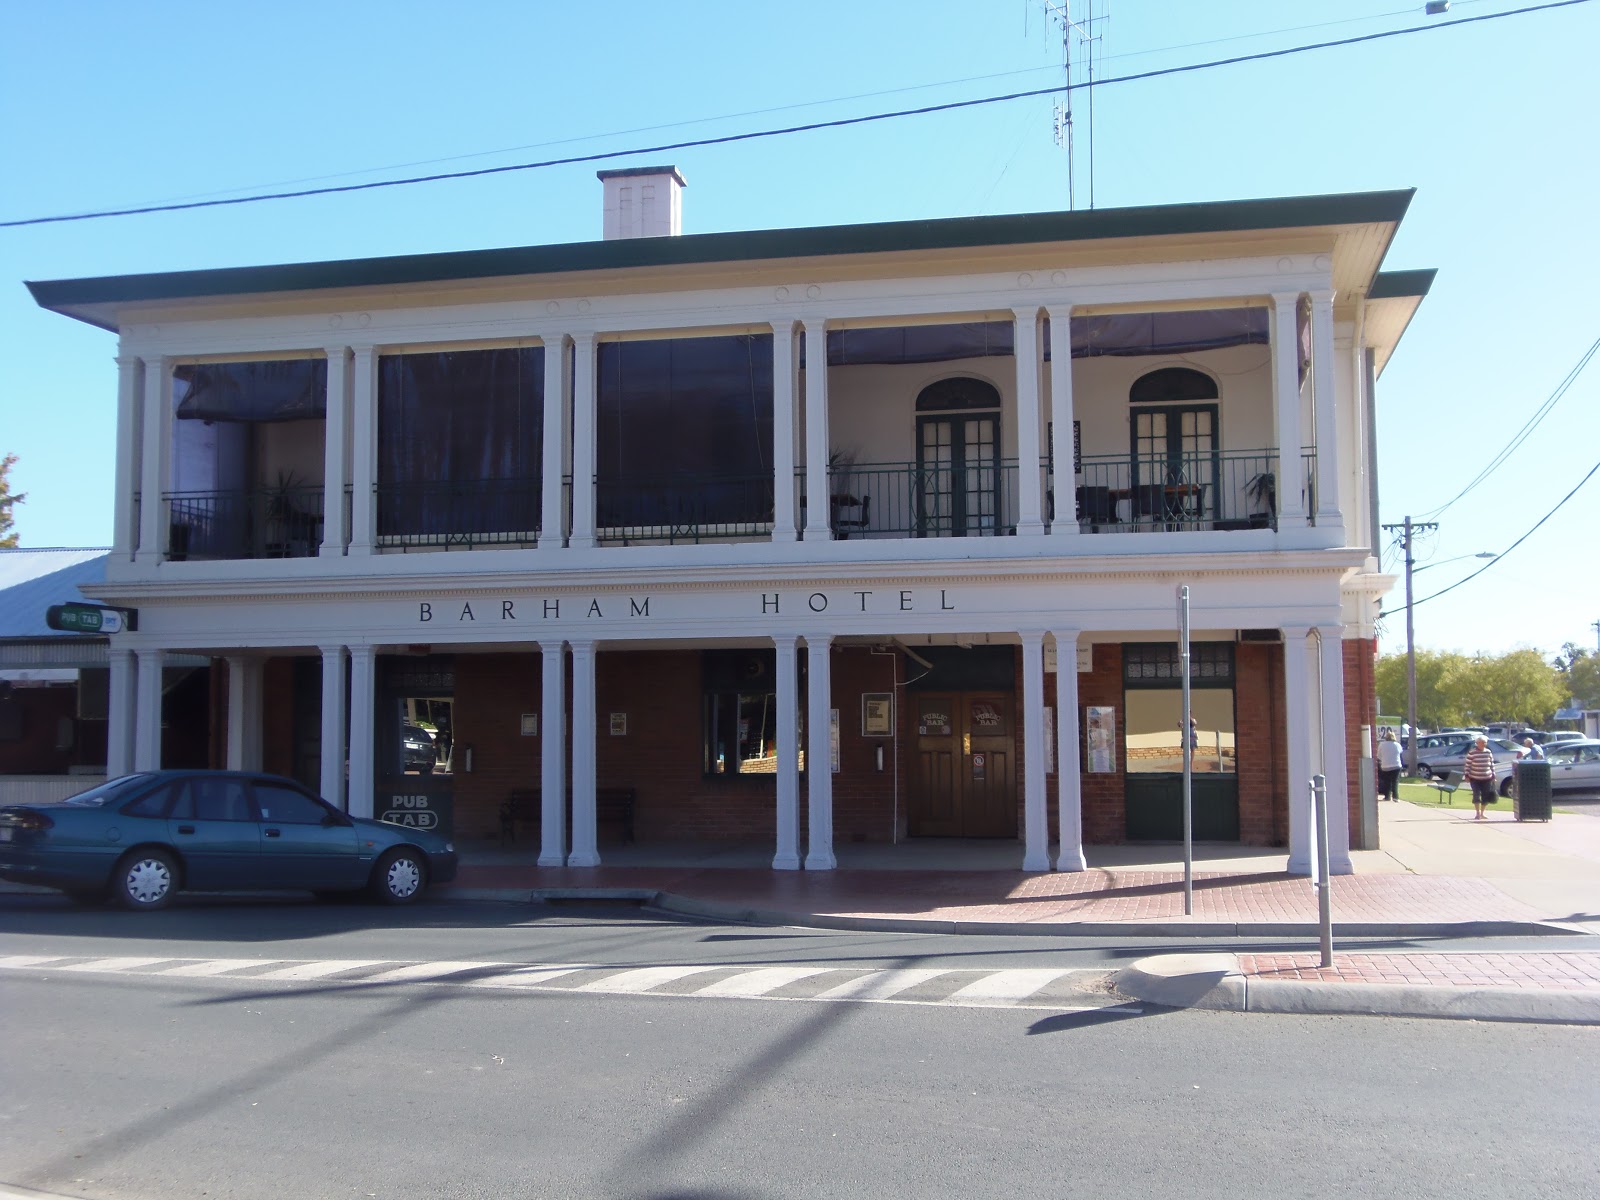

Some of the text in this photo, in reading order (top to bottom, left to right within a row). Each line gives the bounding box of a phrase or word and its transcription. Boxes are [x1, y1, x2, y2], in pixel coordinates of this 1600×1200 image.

[419, 590, 955, 622] BARHAM HOTEL
[61, 612, 98, 624] PUB TAB
[923, 713, 948, 721] PUBLIC
[976, 713, 1001, 721] PUBLIC
[392, 795, 428, 808] PUB
[388, 813, 430, 826] TAB
